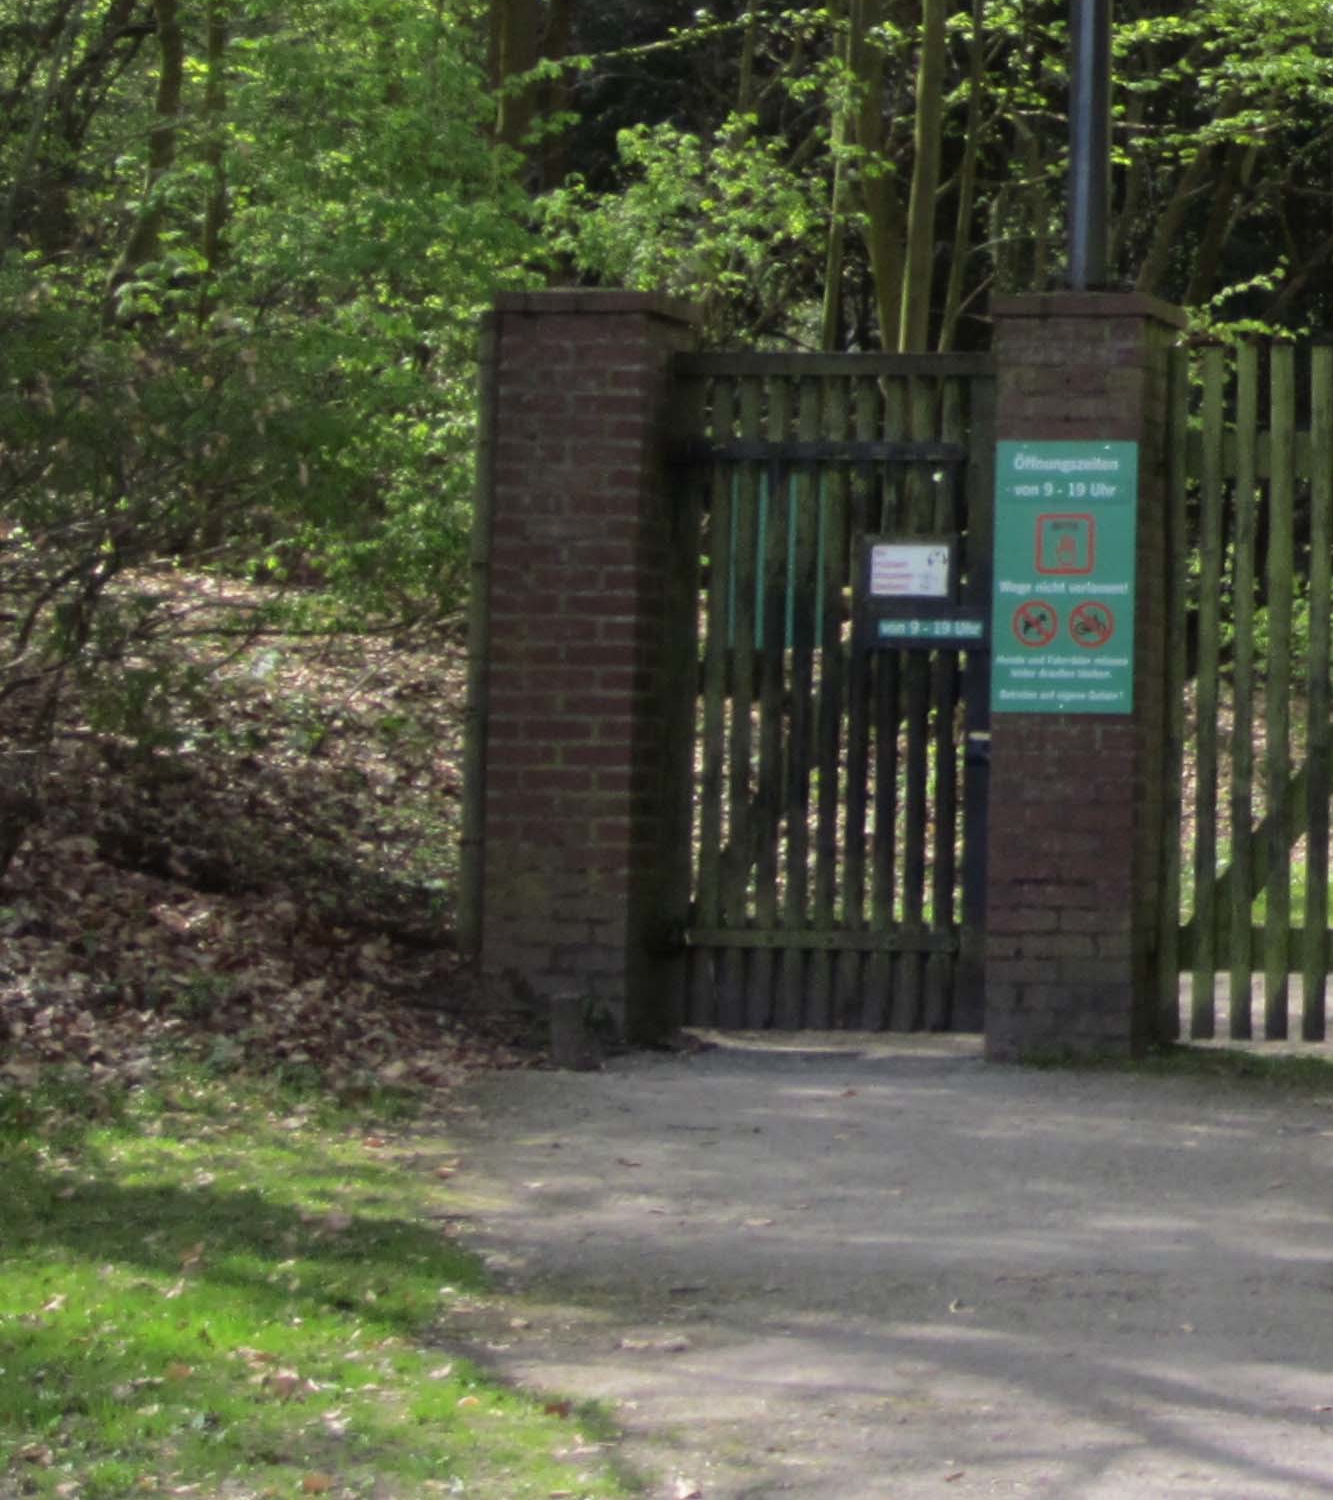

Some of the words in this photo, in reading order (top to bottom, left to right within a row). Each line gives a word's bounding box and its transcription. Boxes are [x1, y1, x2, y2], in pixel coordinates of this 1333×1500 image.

[1014, 452, 1119, 473] Öffnungszeiten
[1013, 486, 1039, 497] von
[1043, 482, 1053, 497] 9
[1069, 482, 1086, 497] 19
[1090, 482, 1117, 497] Uhr
[910, 620, 920, 635] 9
